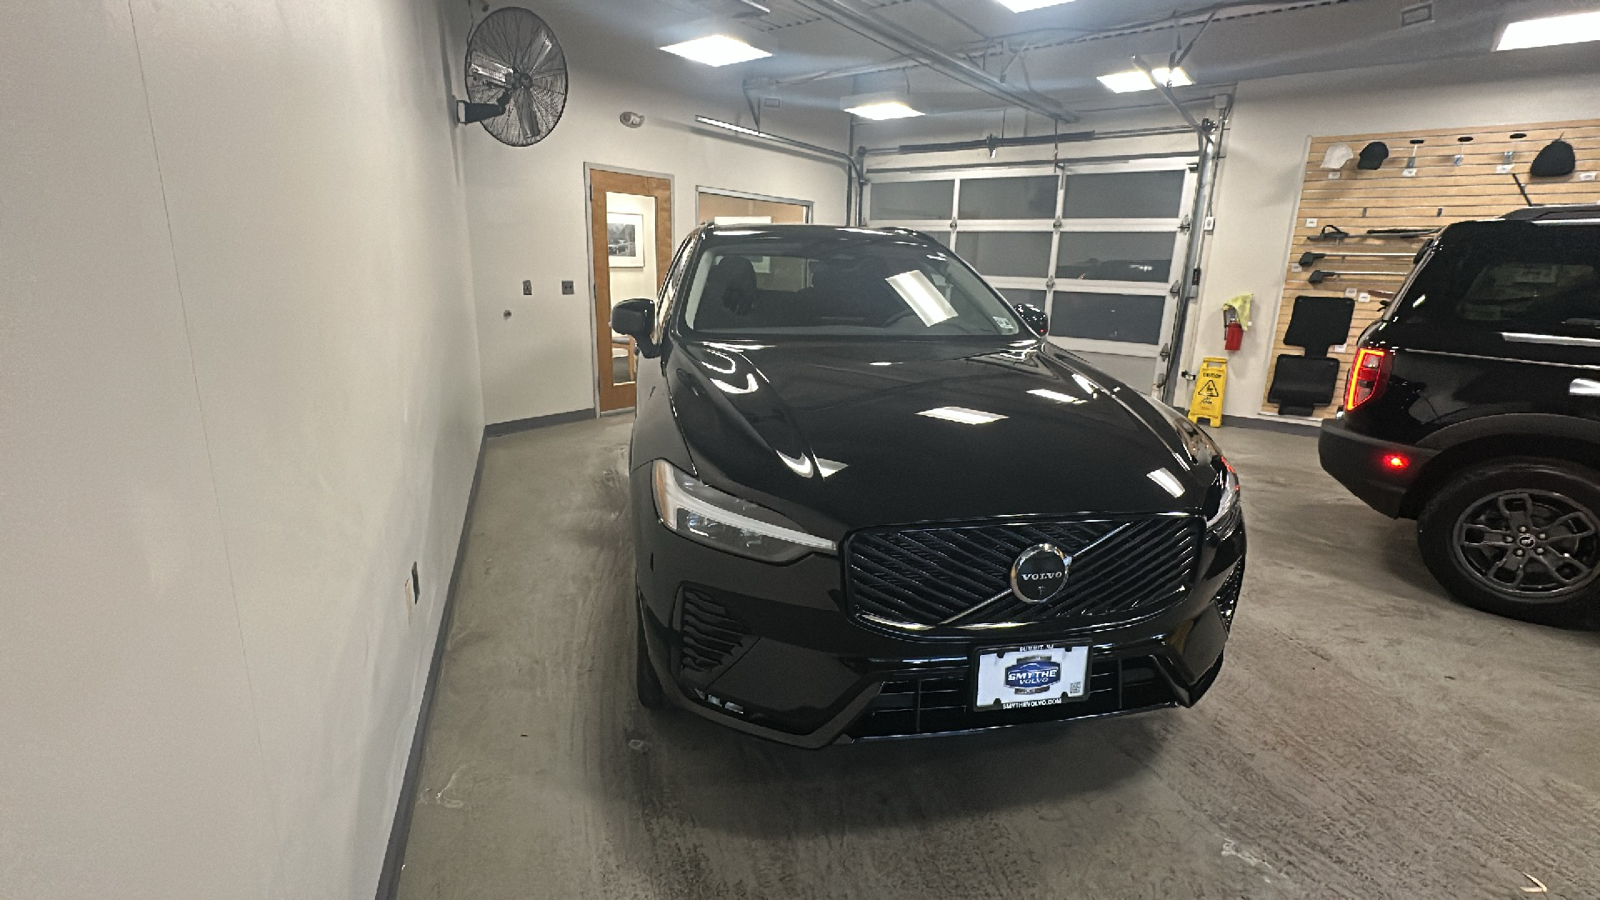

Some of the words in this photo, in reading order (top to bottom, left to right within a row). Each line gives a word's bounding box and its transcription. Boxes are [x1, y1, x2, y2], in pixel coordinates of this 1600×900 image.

[1021, 571, 1063, 581] VOLVO
[1007, 669, 1058, 681] SMYTHE
[1019, 676, 1049, 685] VOLVO
